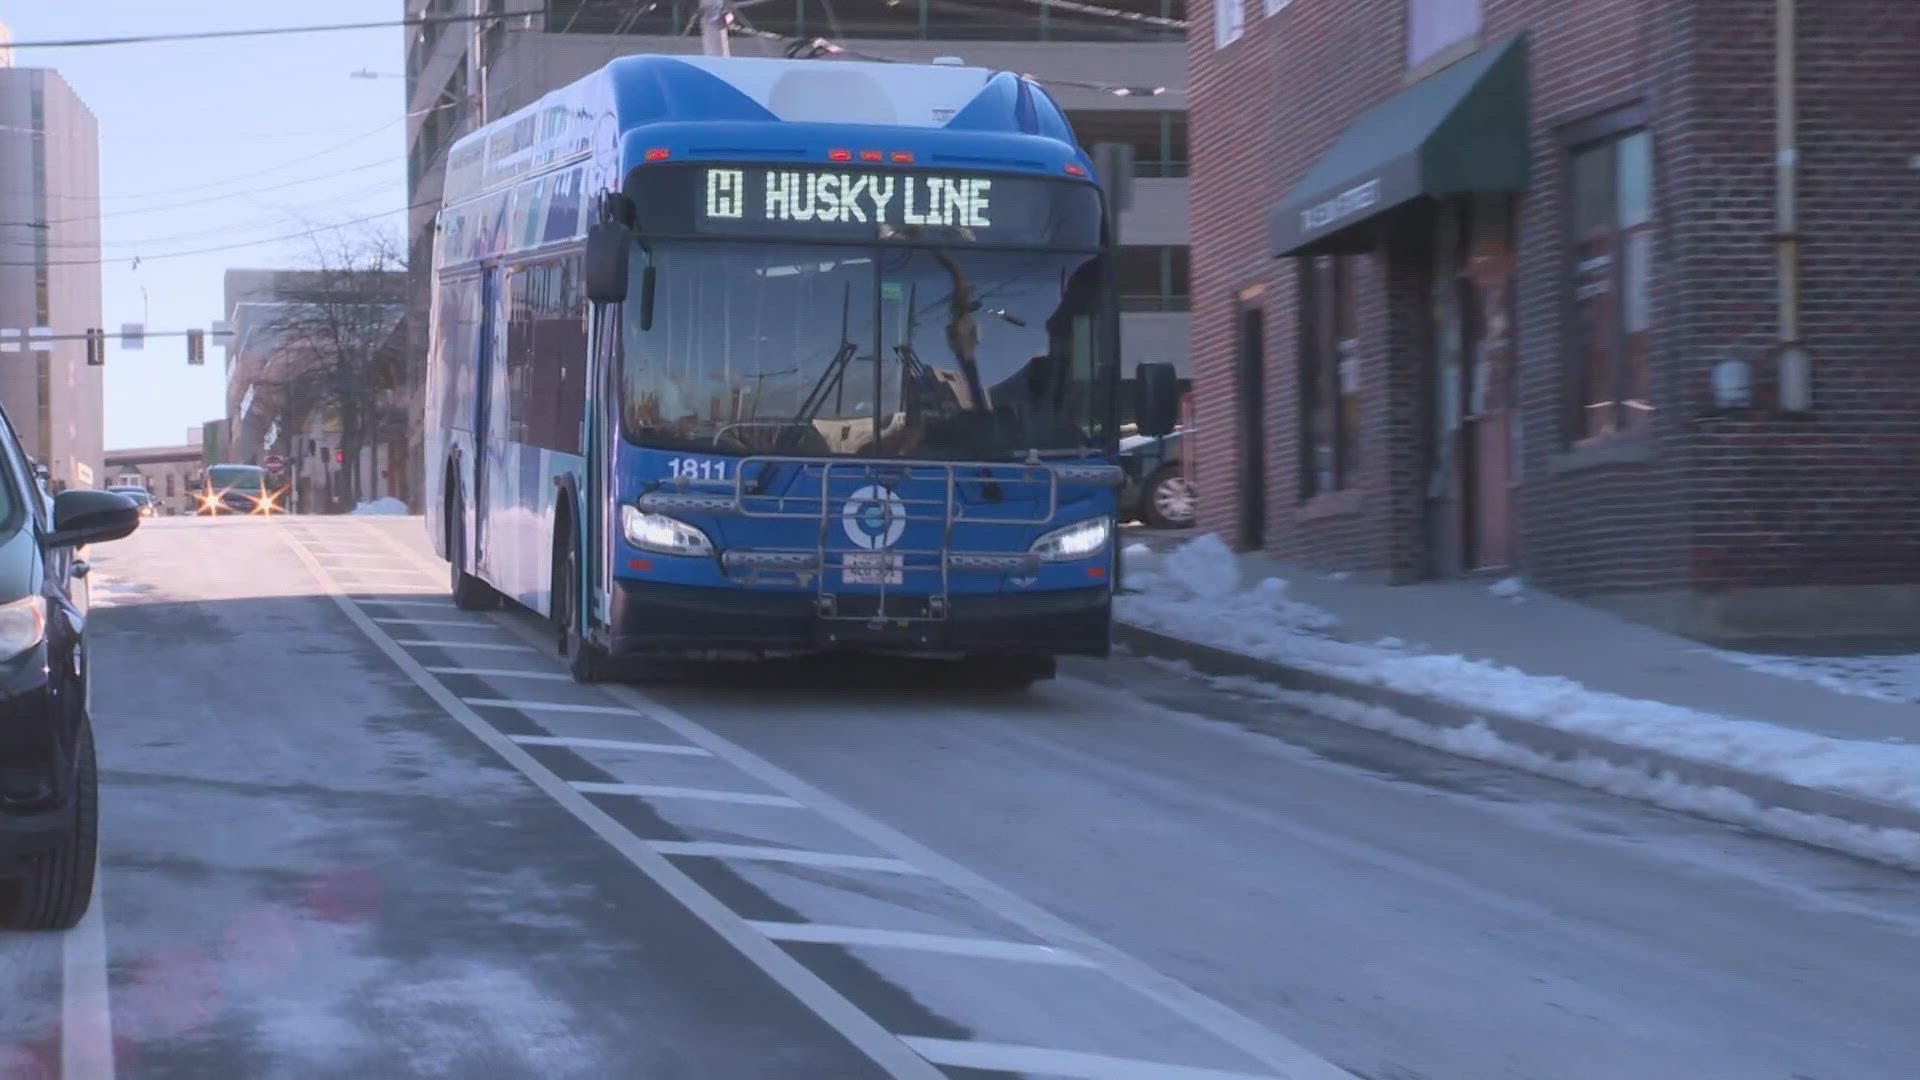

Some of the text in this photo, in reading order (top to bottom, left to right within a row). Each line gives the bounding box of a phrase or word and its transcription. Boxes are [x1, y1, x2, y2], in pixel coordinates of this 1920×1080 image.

[765, 171, 895, 223] HUSKY
[903, 176, 992, 227] LINE
[668, 458, 726, 481] 1811
